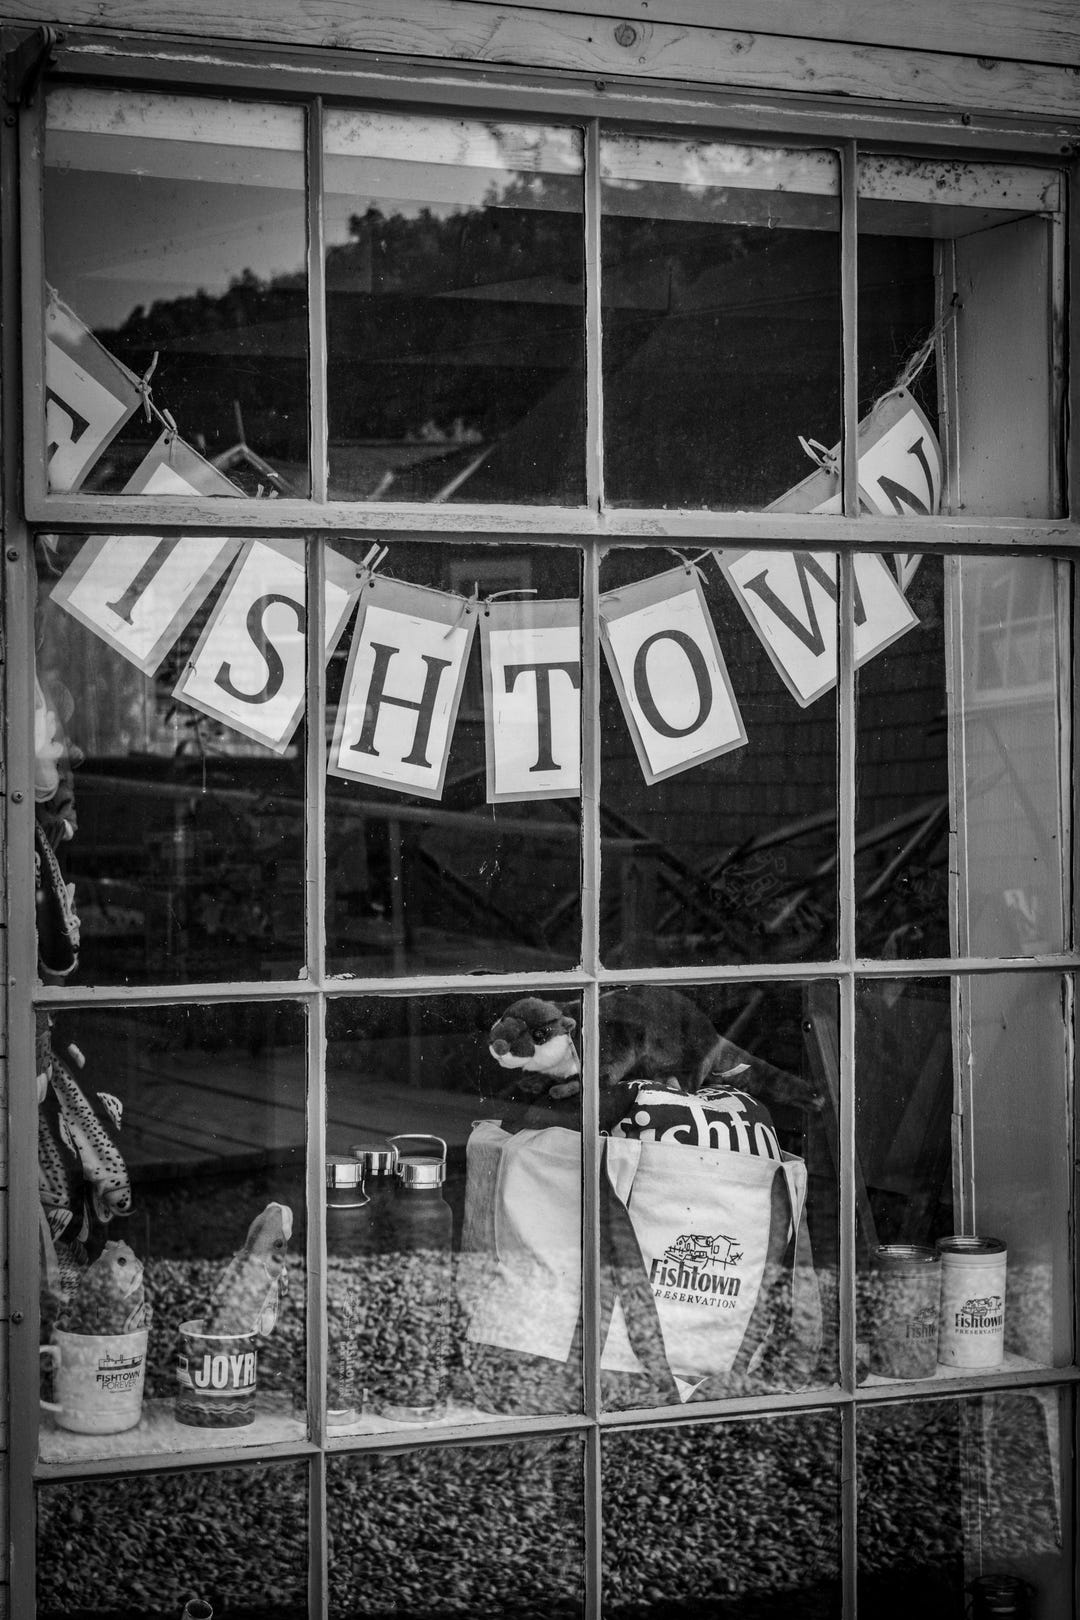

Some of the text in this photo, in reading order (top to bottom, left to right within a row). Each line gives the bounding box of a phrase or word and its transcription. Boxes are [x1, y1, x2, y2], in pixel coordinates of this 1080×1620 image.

[650, 1258, 741, 1296] Fishtown
[955, 1313, 1003, 1329] Fishtown
[96, 1371, 140, 1382] FISHTOWN
[102, 1379, 137, 1390] FOREVER
